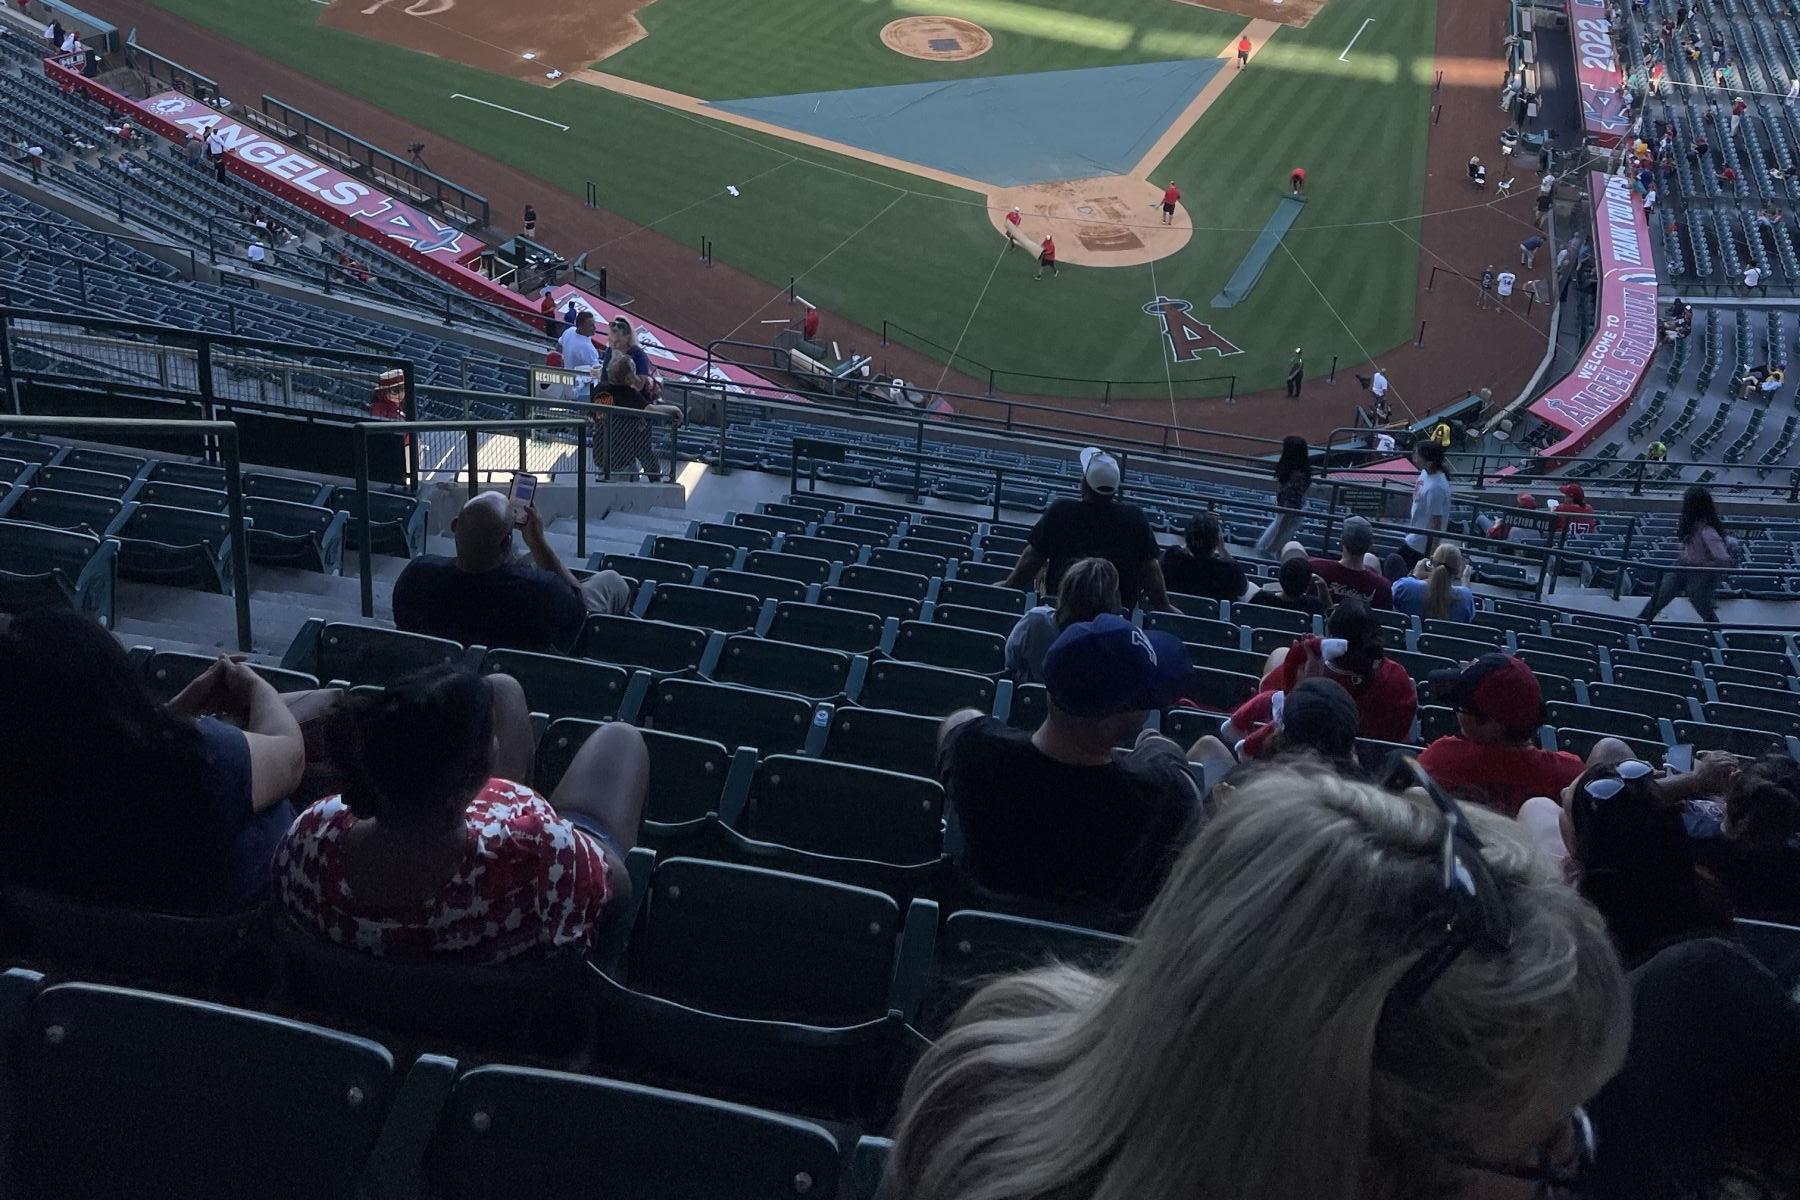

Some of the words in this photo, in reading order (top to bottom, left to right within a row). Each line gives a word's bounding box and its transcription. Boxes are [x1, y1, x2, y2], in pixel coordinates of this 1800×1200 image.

[1576, 18, 1617, 73] 2022
[175, 114, 370, 205] ANGELS
[1607, 200, 1635, 226] YOU
[1609, 223, 1642, 265] THANK
[1545, 365, 1638, 428] ANGEL
[1611, 286, 1658, 369] STADIUM
[1578, 330, 1618, 380] WELCOME
[1606, 314, 1620, 328] TO
[535, 371, 561, 384] SECTION
[1504, 514, 1535, 529] SECTION
[1568, 521, 1590, 535] 17
